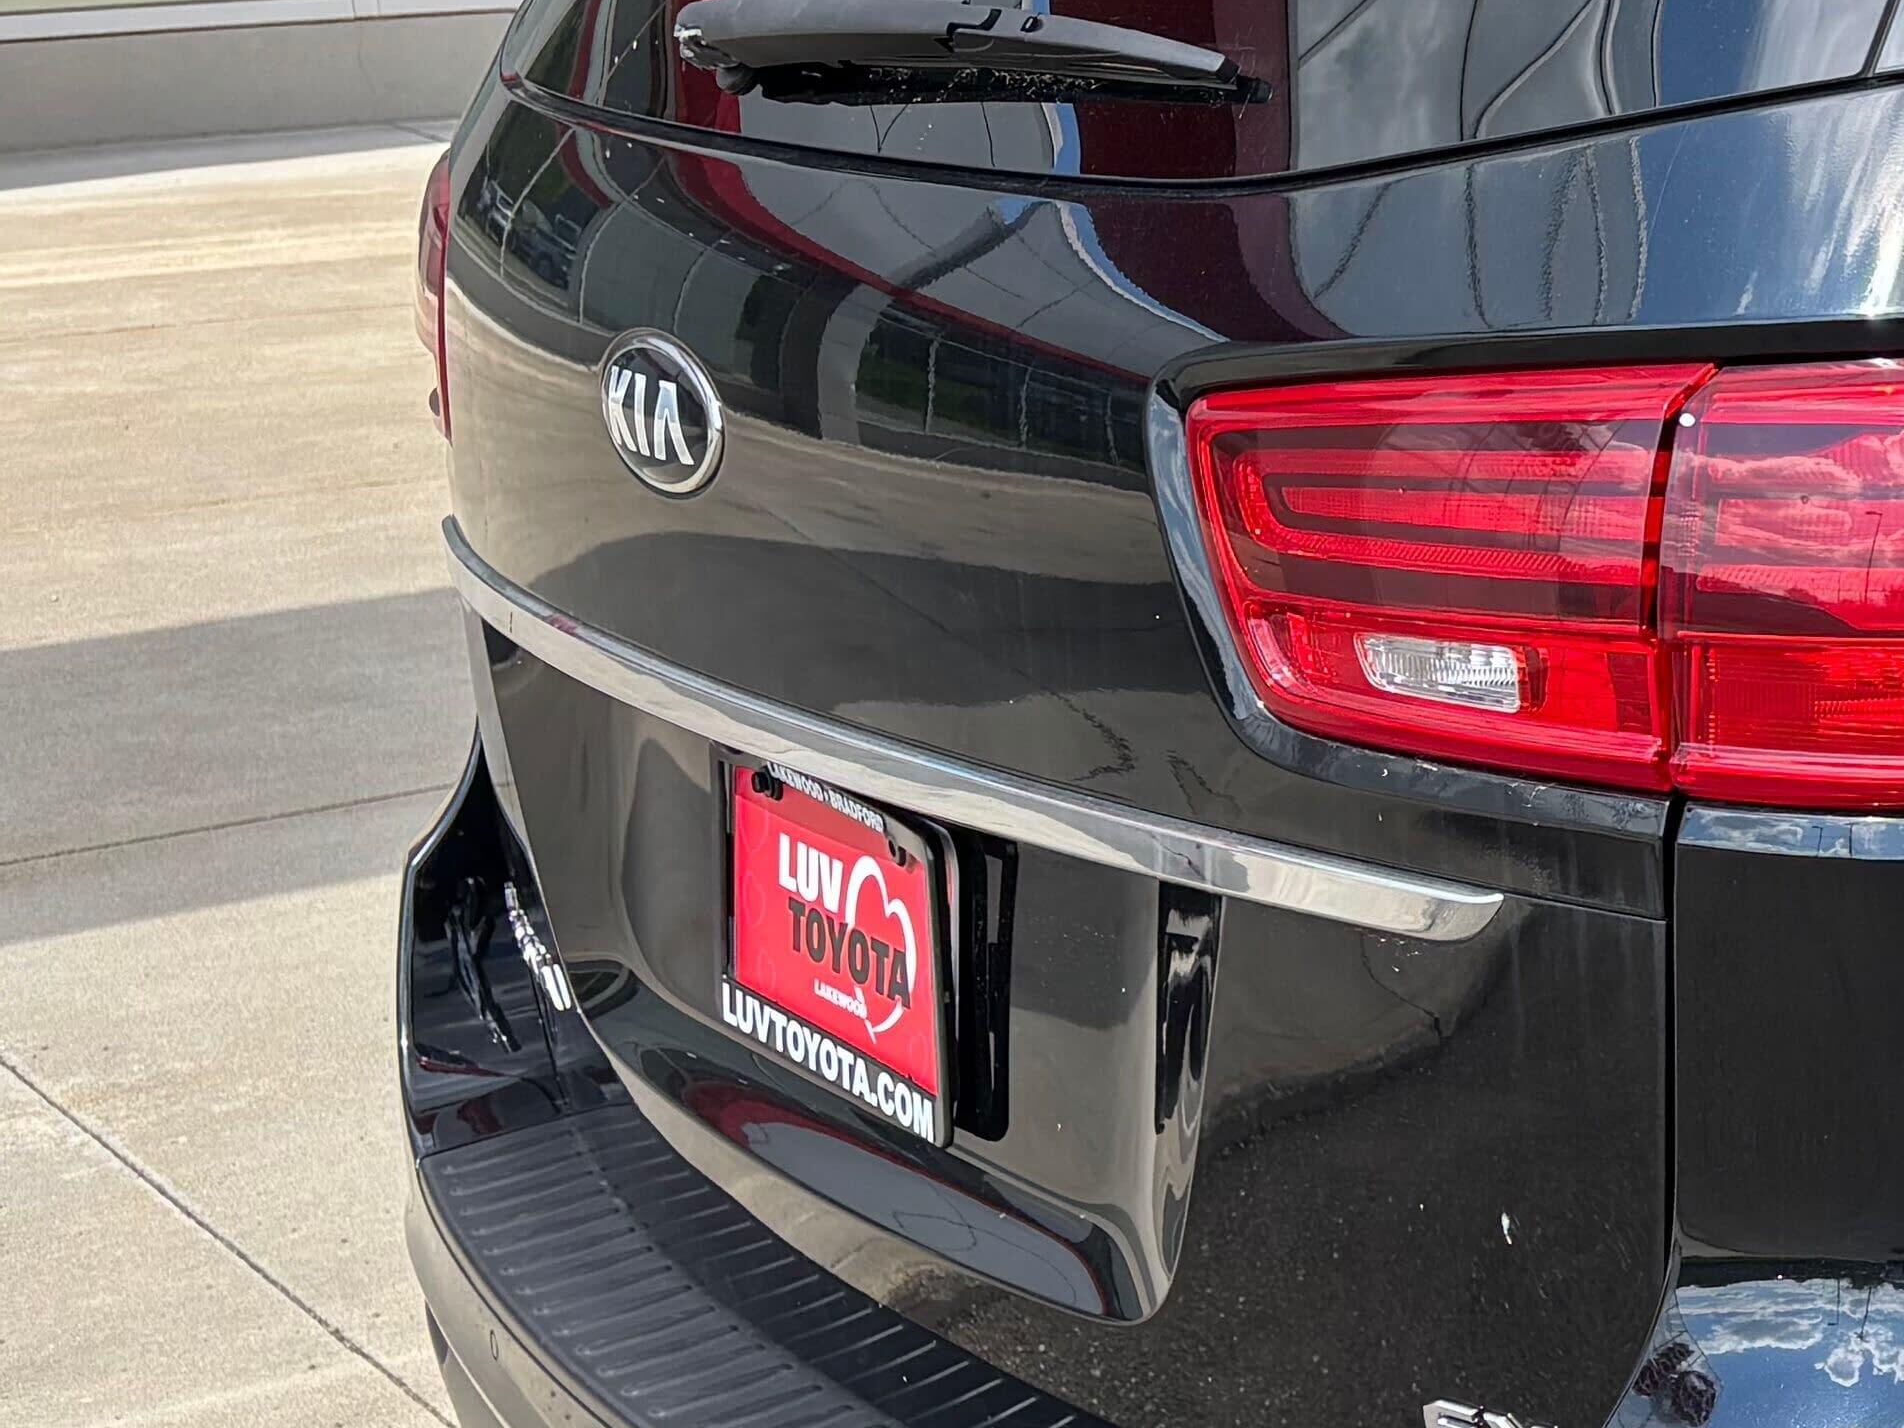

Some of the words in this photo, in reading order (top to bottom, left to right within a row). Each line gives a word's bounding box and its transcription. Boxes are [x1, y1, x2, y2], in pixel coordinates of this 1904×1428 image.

[608, 365, 694, 465] KIA
[767, 762, 823, 802] LAKEWOOD
[828, 790, 885, 833] BRADFORD
[779, 833, 843, 910] LUV
[788, 897, 911, 1009] TOYOTA
[722, 981, 934, 1143] LUVTOYOTA.COM
